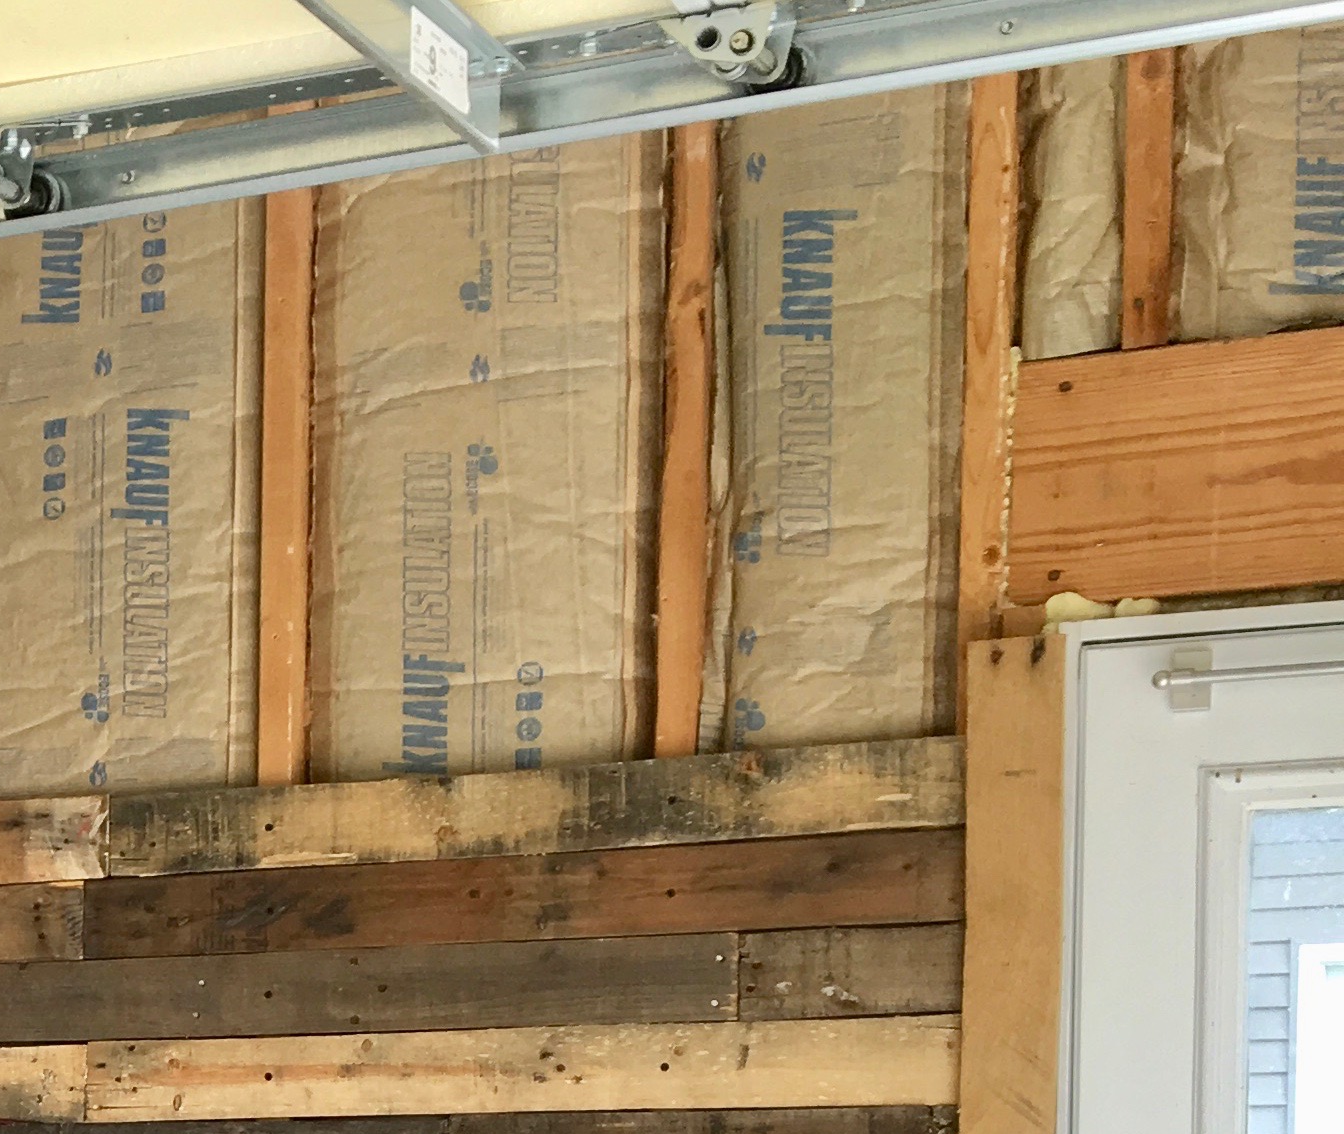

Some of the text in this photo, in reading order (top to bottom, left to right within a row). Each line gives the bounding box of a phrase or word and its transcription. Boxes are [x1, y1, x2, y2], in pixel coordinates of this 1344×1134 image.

[21, 223, 98, 323] KNAU
[763, 208, 858, 557] KNAUF INSULATION
[111, 406, 190, 720] KNAUF INSULATION
[382, 450, 465, 775] KNAUF INSULATION
